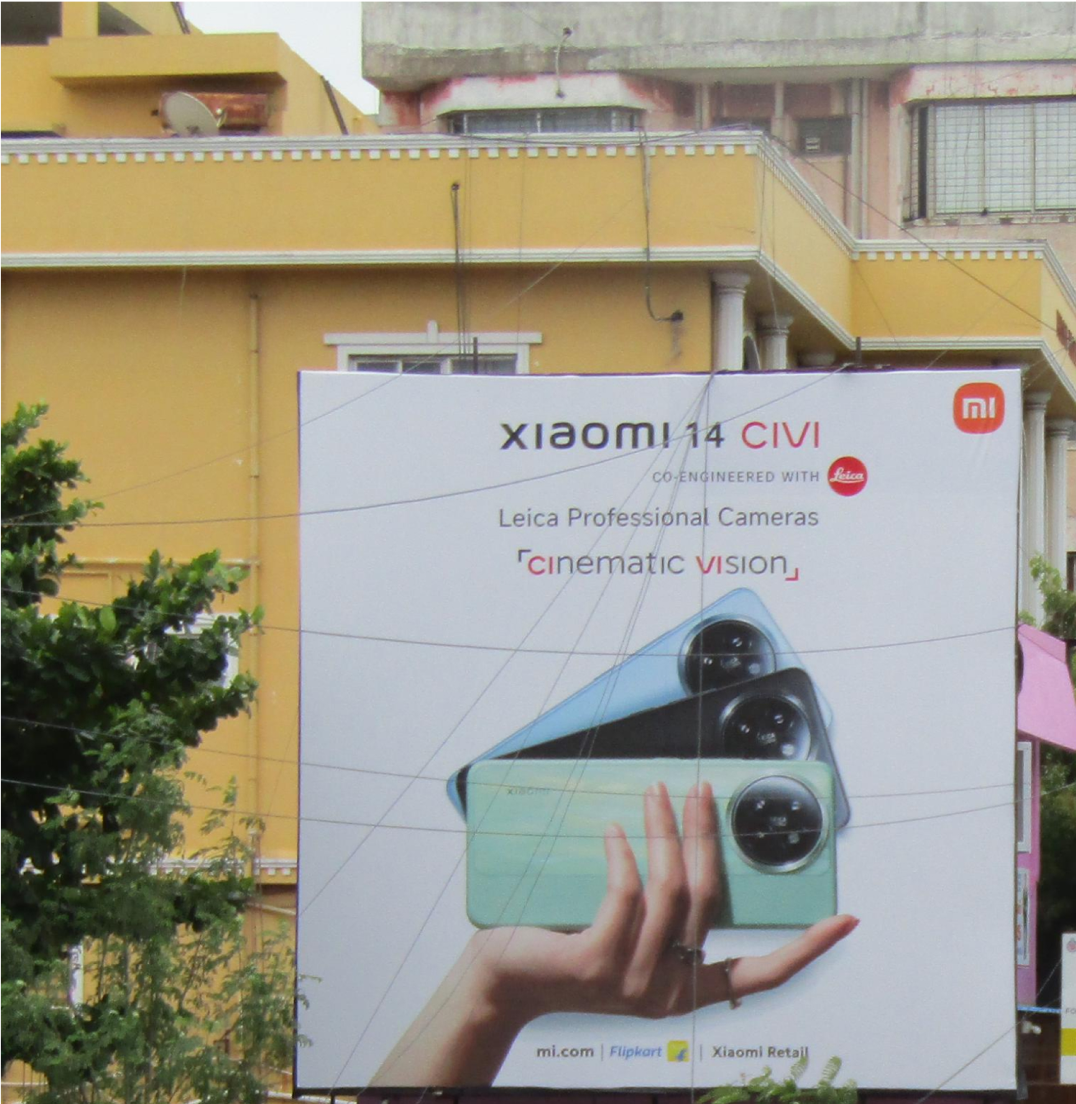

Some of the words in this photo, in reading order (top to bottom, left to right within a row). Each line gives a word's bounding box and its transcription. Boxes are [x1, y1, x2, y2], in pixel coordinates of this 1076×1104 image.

[686, 421, 725, 450] 14
[740, 420, 821, 450] CIVI
[652, 471, 775, 483] CO-ENGINEERED
[782, 471, 820, 483] WITH
[829, 466, 865, 484] Leica
[498, 507, 559, 528] Leica
[567, 506, 710, 528] Professional
[718, 507, 820, 528] Cameras
[536, 1045, 595, 1058] mi.com
[609, 1045, 663, 1060] Flipkart
[712, 1045, 764, 1058] Xiaomi
[767, 1045, 809, 1058] Retail
